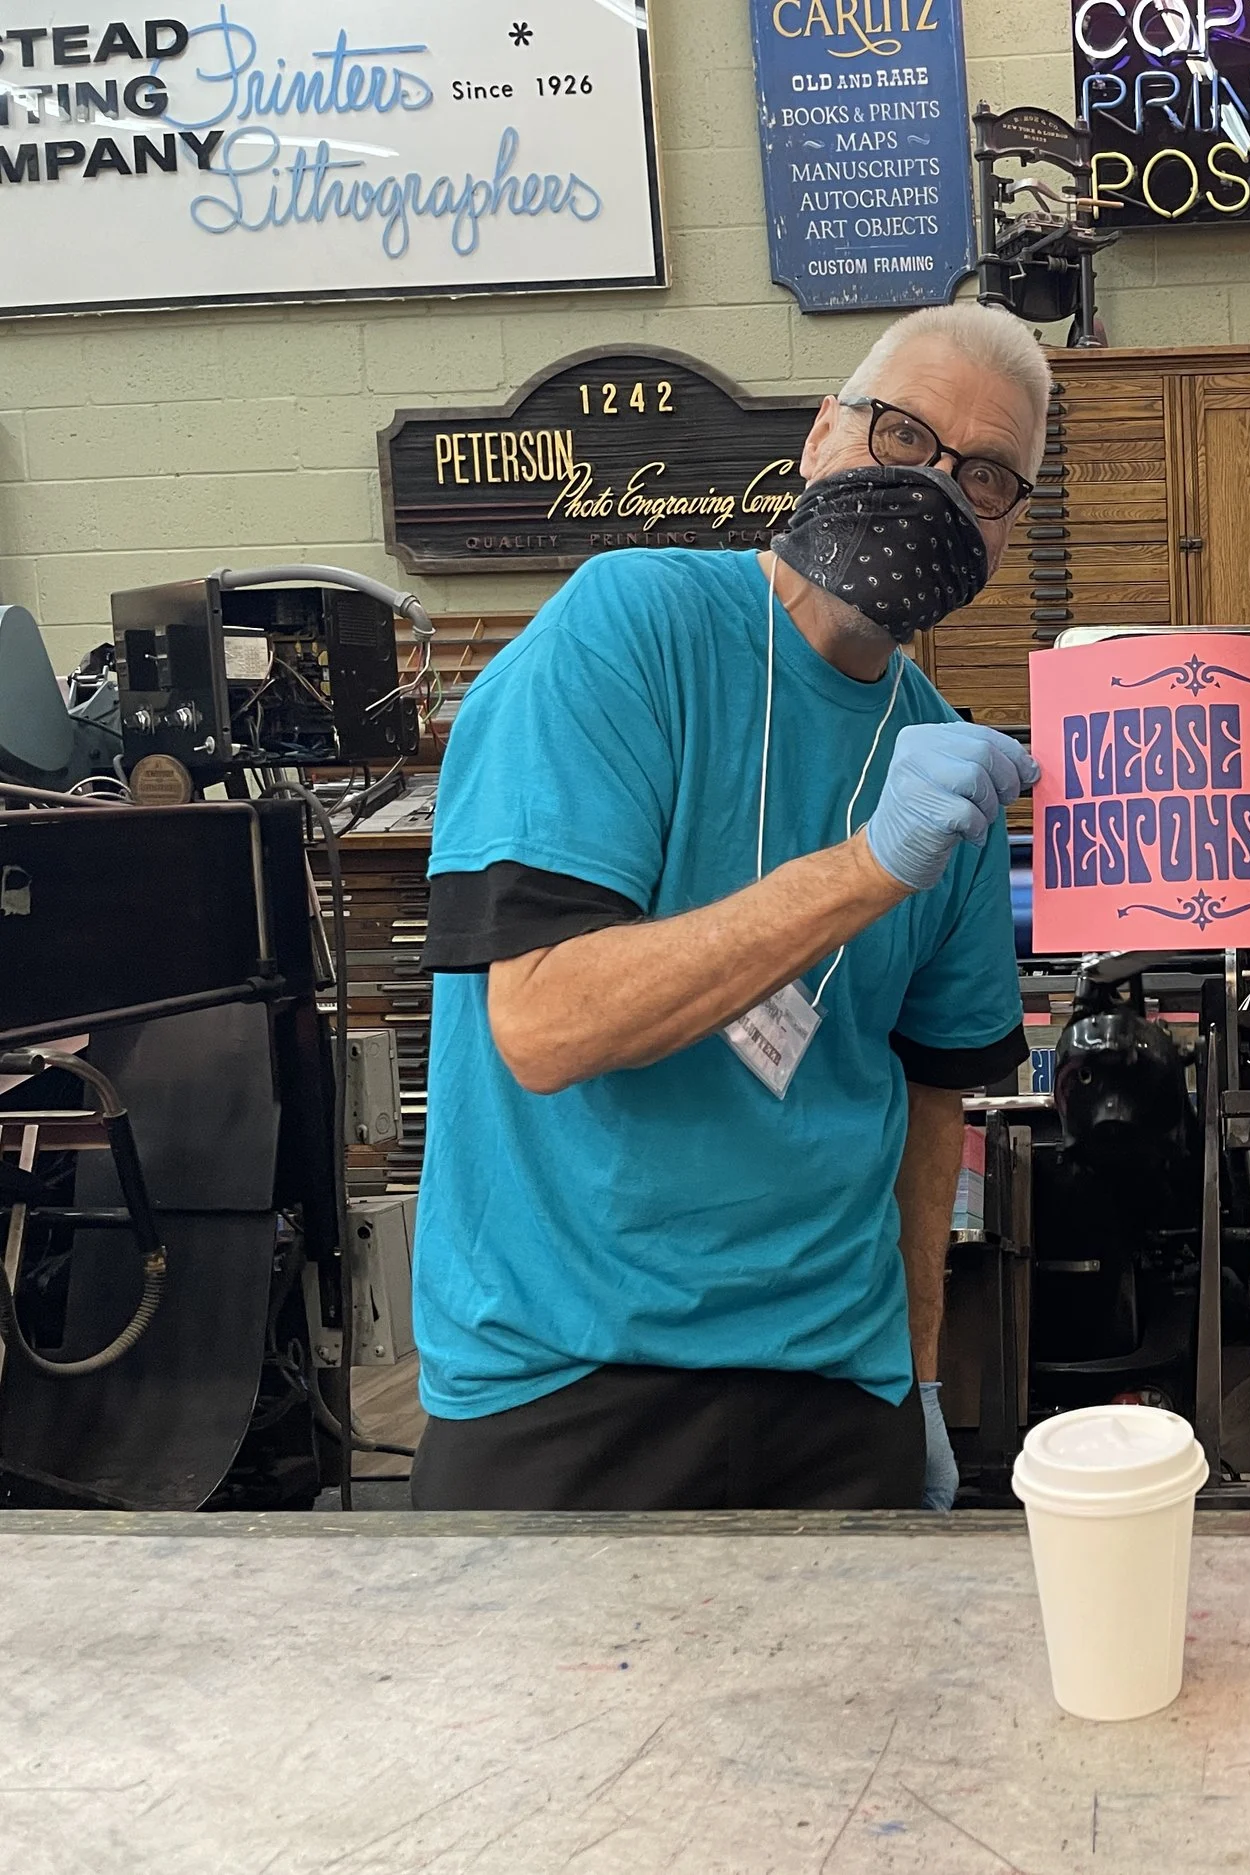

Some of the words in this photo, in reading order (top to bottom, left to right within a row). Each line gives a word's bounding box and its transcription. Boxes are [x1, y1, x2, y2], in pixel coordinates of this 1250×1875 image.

[0, 19, 189, 67] TEAD
[772, 0, 938, 57] CARLITZ
[151, 4, 433, 130] Printers
[792, 73, 832, 92] OLD
[837, 73, 873, 89] AND
[877, 67, 929, 88] RARE
[0, 75, 169, 126] TING
[452, 79, 514, 100] Since
[535, 74, 593, 96] 1926
[781, 105, 850, 127] BOOKS
[853, 107, 865, 123] &
[870, 100, 940, 122] PRINTS
[835, 131, 898, 152] MAPS
[791, 157, 940, 183] MANUSCRIPTS
[186, 126, 602, 258] Lithographers
[800, 187, 939, 212] AUTOGRAPHS
[804, 219, 848, 240] ART
[854, 216, 938, 238] OBJECTS
[808, 258, 867, 276] CUSTOM
[874, 255, 934, 274] FRAMING
[579, 381, 674, 415] 1242
[435, 429, 574, 484] PETERSON
[547, 462, 613, 520] Photo
[617, 461, 735, 532] Engraving
[466, 534, 558, 549] QUALITY
[588, 531, 697, 546] PRINTING
[1063, 703, 1242, 800] PLEASE
